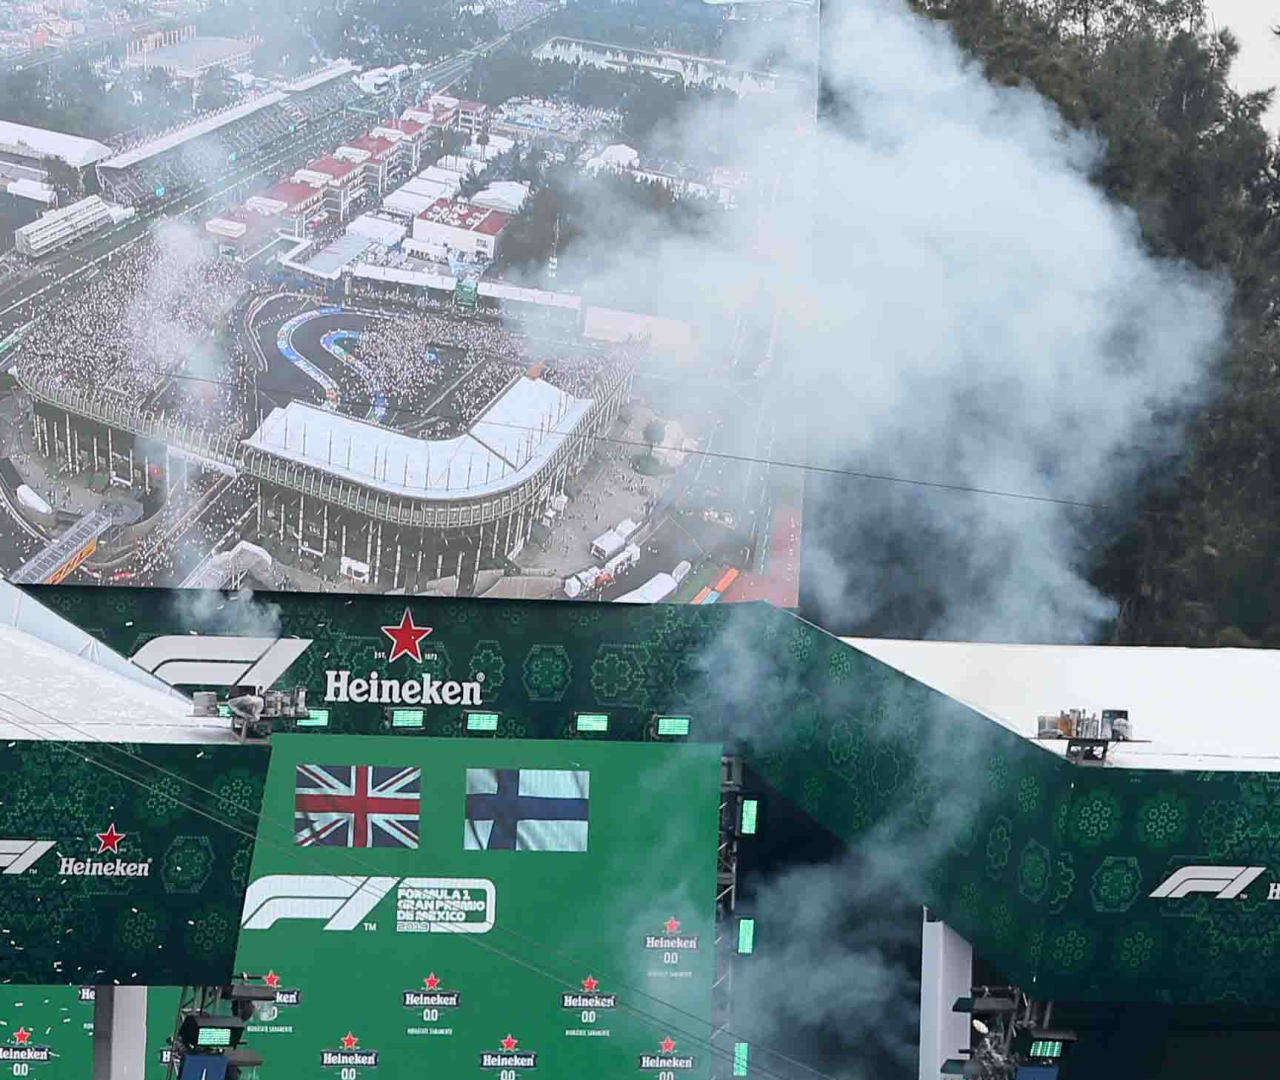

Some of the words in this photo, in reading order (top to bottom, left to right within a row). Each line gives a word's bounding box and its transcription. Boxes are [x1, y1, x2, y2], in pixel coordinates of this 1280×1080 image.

[324, 670, 483, 706] Heineken
[58, 858, 150, 877] Heineken
[646, 936, 696, 949] Heineken
[405, 994, 457, 1006] Heineken
[564, 995, 614, 1007] Heineken
[323, 1053, 375, 1065] Heineken
[482, 1054, 534, 1067] Heineken
[642, 1056, 692, 1069] Heineken
